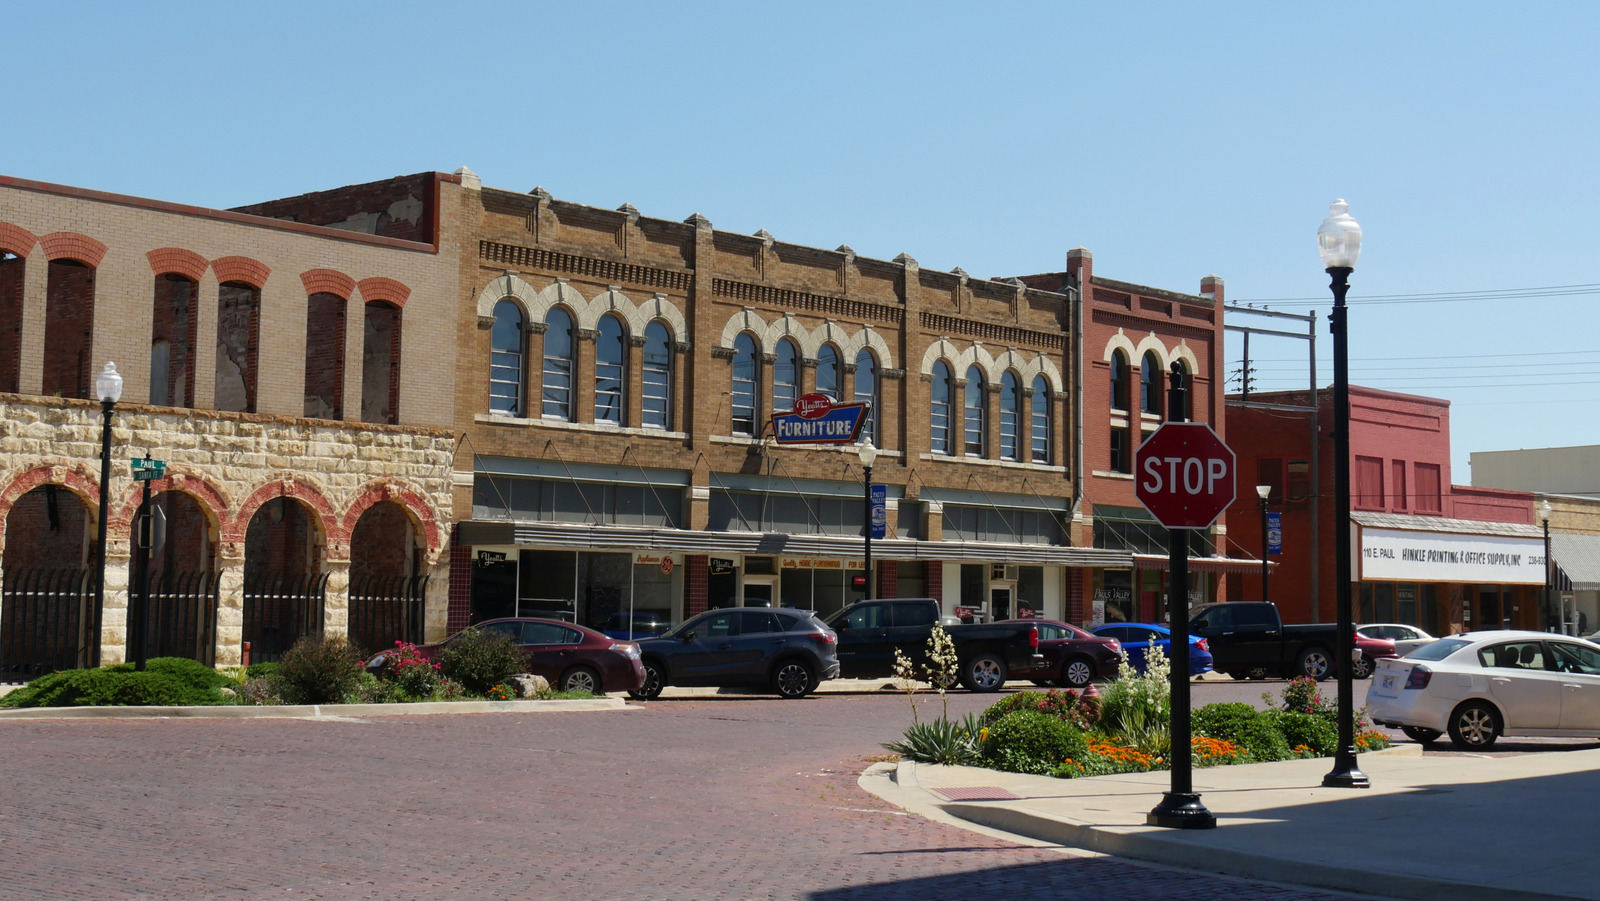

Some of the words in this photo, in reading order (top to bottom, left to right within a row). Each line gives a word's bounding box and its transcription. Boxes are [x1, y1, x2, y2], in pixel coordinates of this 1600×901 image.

[777, 418, 852, 438] FURNITURE
[140, 459, 156, 469] PAUL
[138, 471, 152, 480] SANTA
[152, 470, 159, 479] FE
[1143, 456, 1227, 495] STOP
[1363, 547, 1372, 558] 110
[1380, 548, 1395, 559] PAUL
[1402, 548, 1426, 562] HINKLE
[1427, 549, 1459, 564] PRINTING
[1465, 551, 1486, 565] OFFICE
